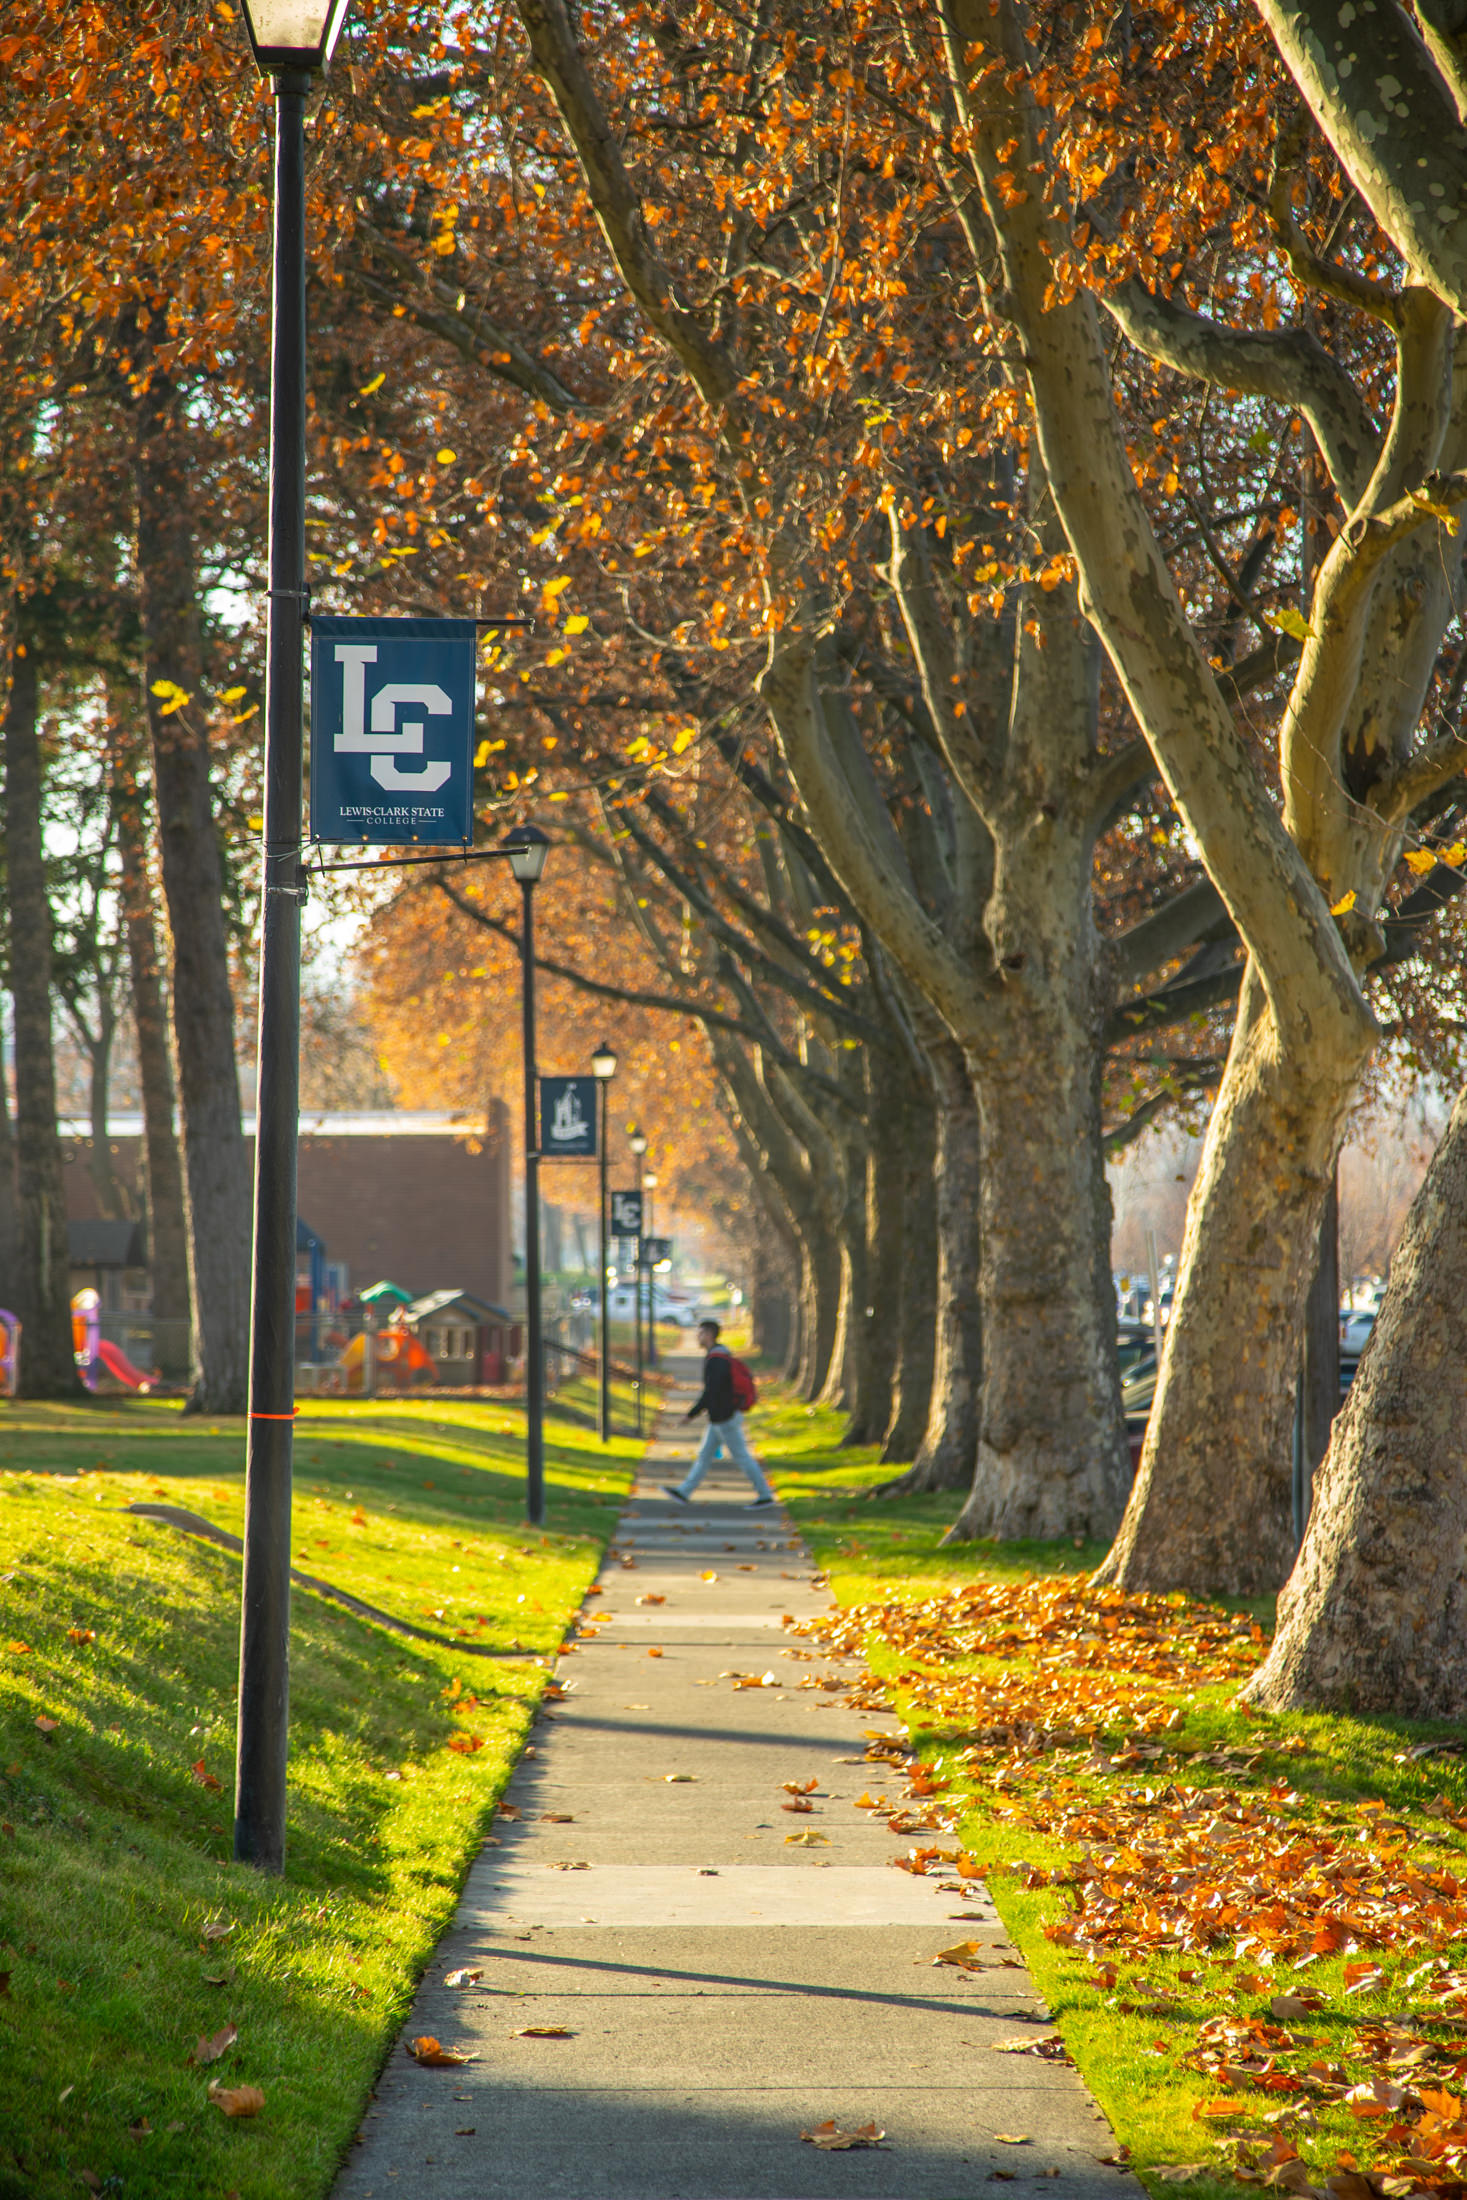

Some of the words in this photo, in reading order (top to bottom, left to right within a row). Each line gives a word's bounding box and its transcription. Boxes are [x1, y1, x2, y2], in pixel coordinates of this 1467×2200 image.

[334, 644, 453, 792] LC
[339, 806, 409, 816] LEWIS-CLARK
[411, 807, 445, 817] STATE
[366, 817, 417, 825] COLLEGE
